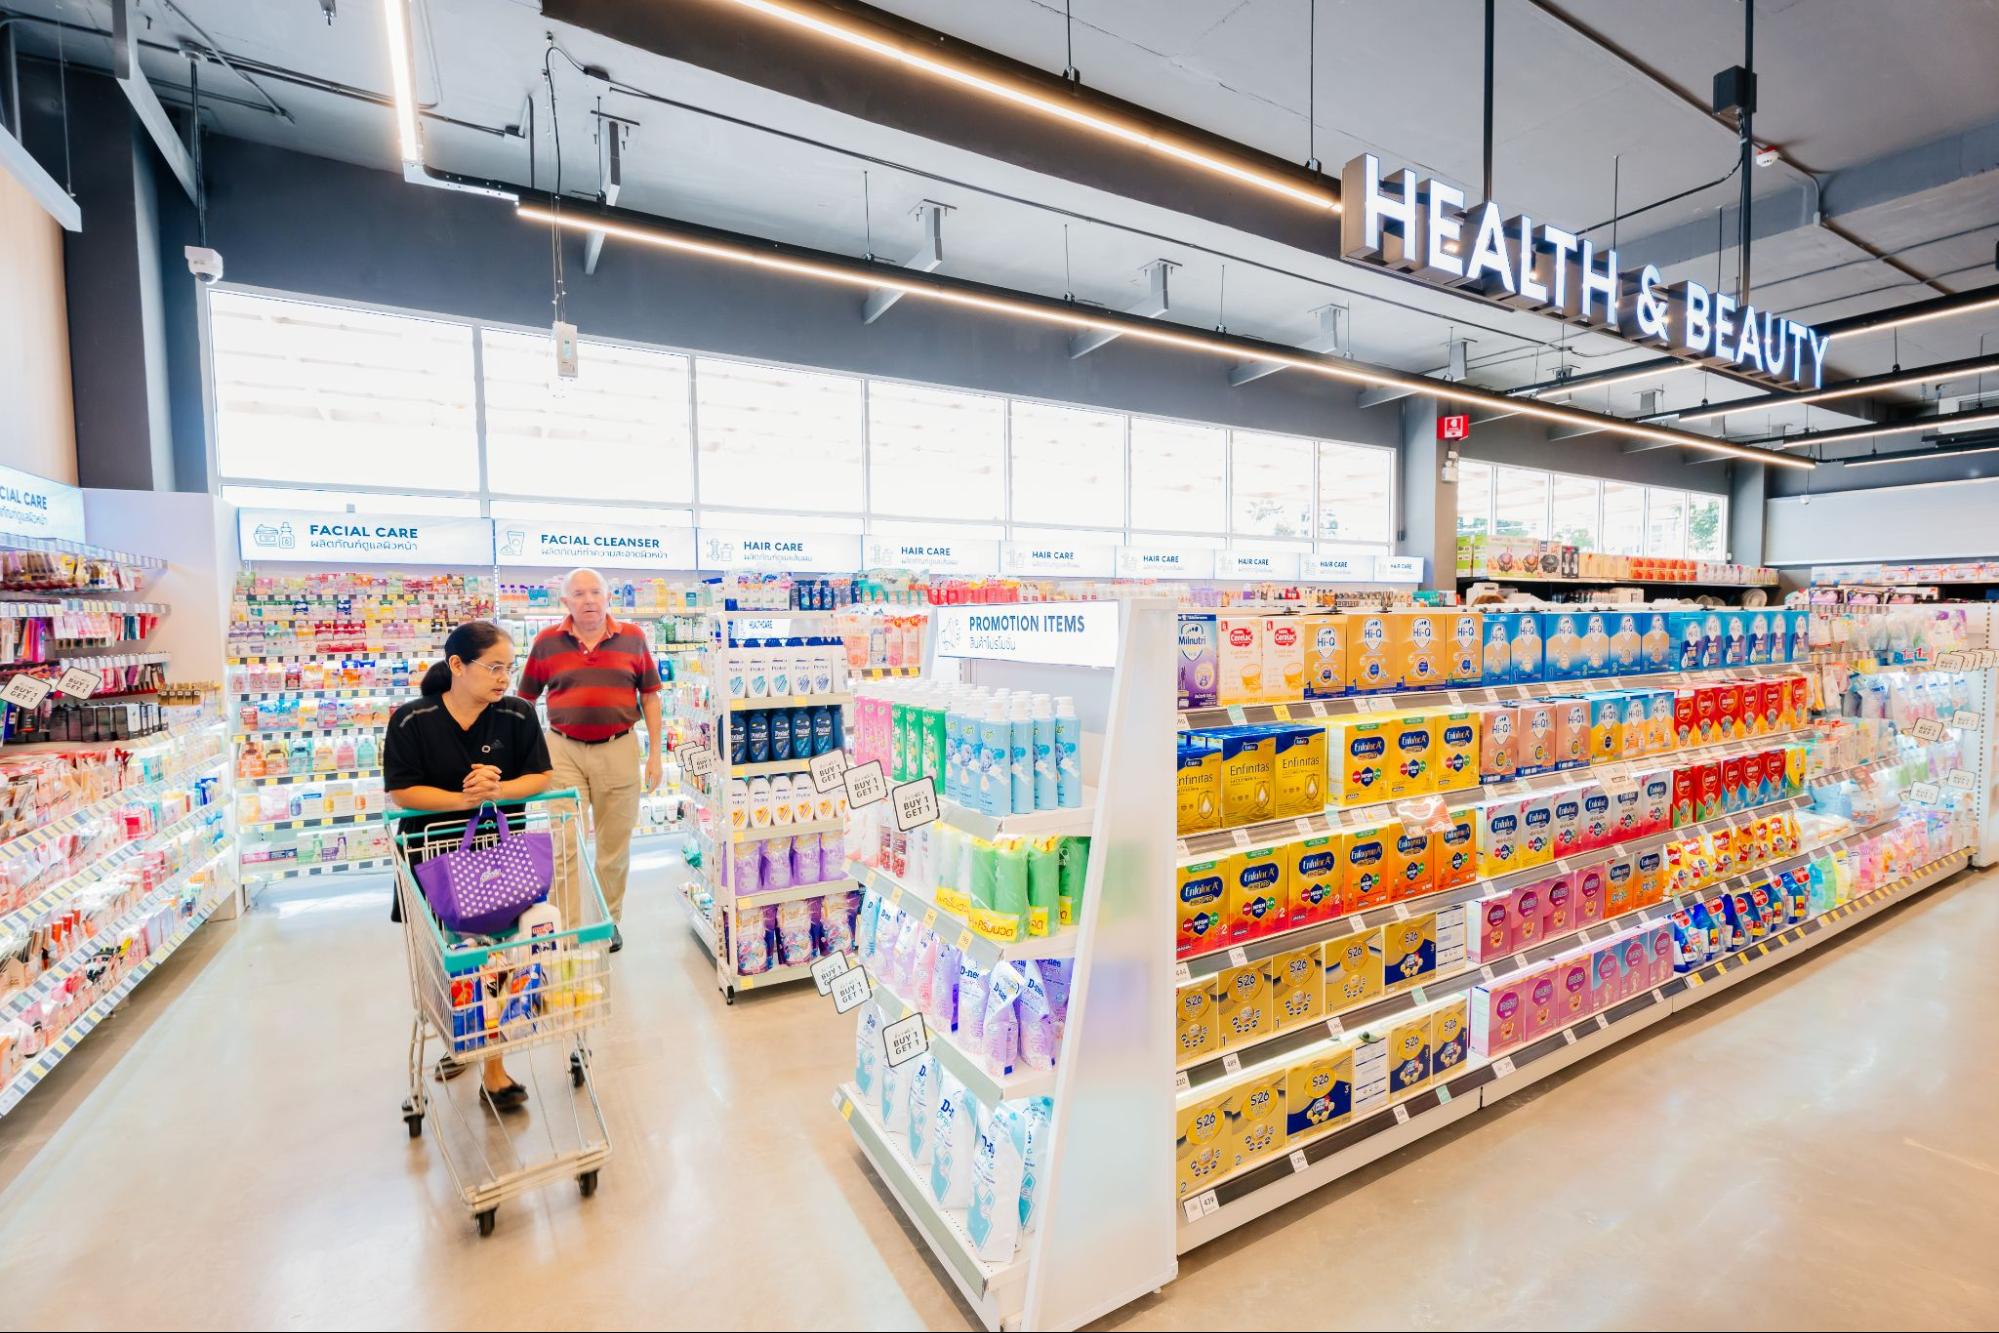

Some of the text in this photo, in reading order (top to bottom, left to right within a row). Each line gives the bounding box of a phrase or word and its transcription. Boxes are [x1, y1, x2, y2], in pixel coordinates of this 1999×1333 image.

[1362, 152, 1832, 389] HEALTH & BEAUTY
[23, 492, 48, 510] CARE
[309, 525, 418, 538] FACIAL CARE
[541, 534, 660, 548] FACIAL CLEANSER
[743, 541, 803, 552] HAIR CARE
[901, 546, 951, 556] HAIR CARE
[1032, 551, 1074, 560] HAIR CARE
[1143, 555, 1179, 563] HAIR CARE
[1238, 558, 1269, 566] HAIR CARE
[969, 615, 1086, 633] PROMOTION ITEMS
[1365, 628, 1382, 639] Hi-Q
[1413, 627, 1431, 638] Hi-Q
[1457, 627, 1475, 637] Hi-Q
[1178, 635, 1207, 646] Milnutri
[1317, 637, 1336, 648] Hi-Q
[10, 690, 27, 700] GET
[14, 686, 32, 694] BUY
[1282, 755, 1320, 769] Enfinitas
[819, 766, 836, 777] BUY
[1230, 761, 1270, 776] Enfinitas
[821, 774, 837, 783] GET
[854, 780, 872, 791] BUY
[856, 788, 872, 799] GET
[903, 795, 929, 811] BUY 1
[905, 804, 930, 819] GET 1
[1334, 894, 1340, 905] 2
[1279, 907, 1286, 918] 2
[1221, 923, 1228, 935] 2
[820, 970, 837, 981] BUY
[839, 985, 855, 997] BUY
[842, 992, 857, 1004] GET
[893, 1034, 912, 1048] BUY
[1222, 1035, 1228, 1047] 1
[895, 1042, 912, 1055] GET
[1180, 1181, 1187, 1194] 2
